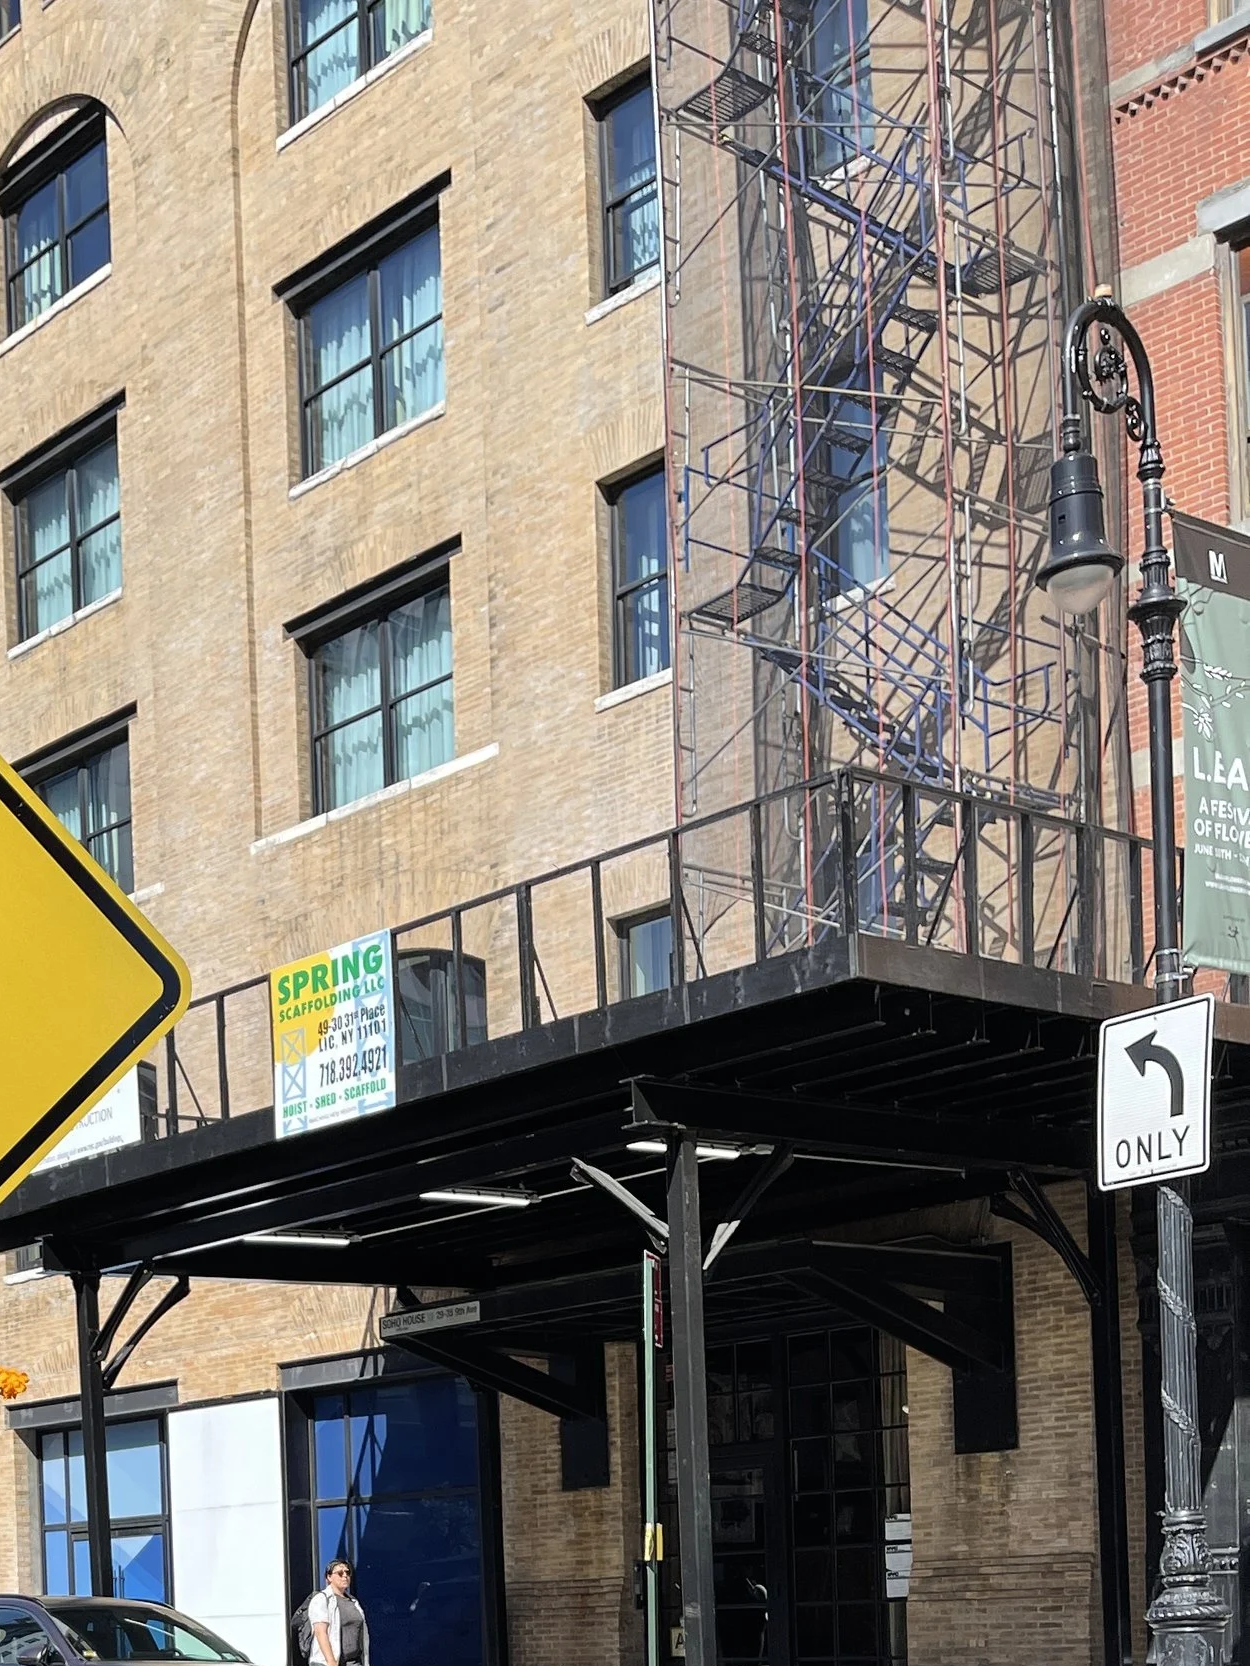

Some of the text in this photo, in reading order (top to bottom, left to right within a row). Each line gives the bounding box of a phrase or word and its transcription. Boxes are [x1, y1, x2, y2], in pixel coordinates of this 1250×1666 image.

[1194, 818, 1212, 838] OF
[1193, 843, 1214, 857] JUNE
[278, 944, 383, 1006] SPRING
[279, 975, 385, 1023] SCAFFOLDING LLC
[318, 1015, 343, 1036] 49-30
[360, 1003, 386, 1023] Place
[341, 1028, 354, 1046] NY
[357, 1018, 386, 1040] 11101
[319, 1044, 387, 1088] 718.392.4921
[282, 1100, 308, 1119] HOIST
[315, 1092, 337, 1109] SHED
[344, 1077, 387, 1101] SCAFFOLD
[1116, 1125, 1190, 1168] ONLY
[382, 1319, 402, 1330] SOHO
[402, 1313, 426, 1326] HOUSE
